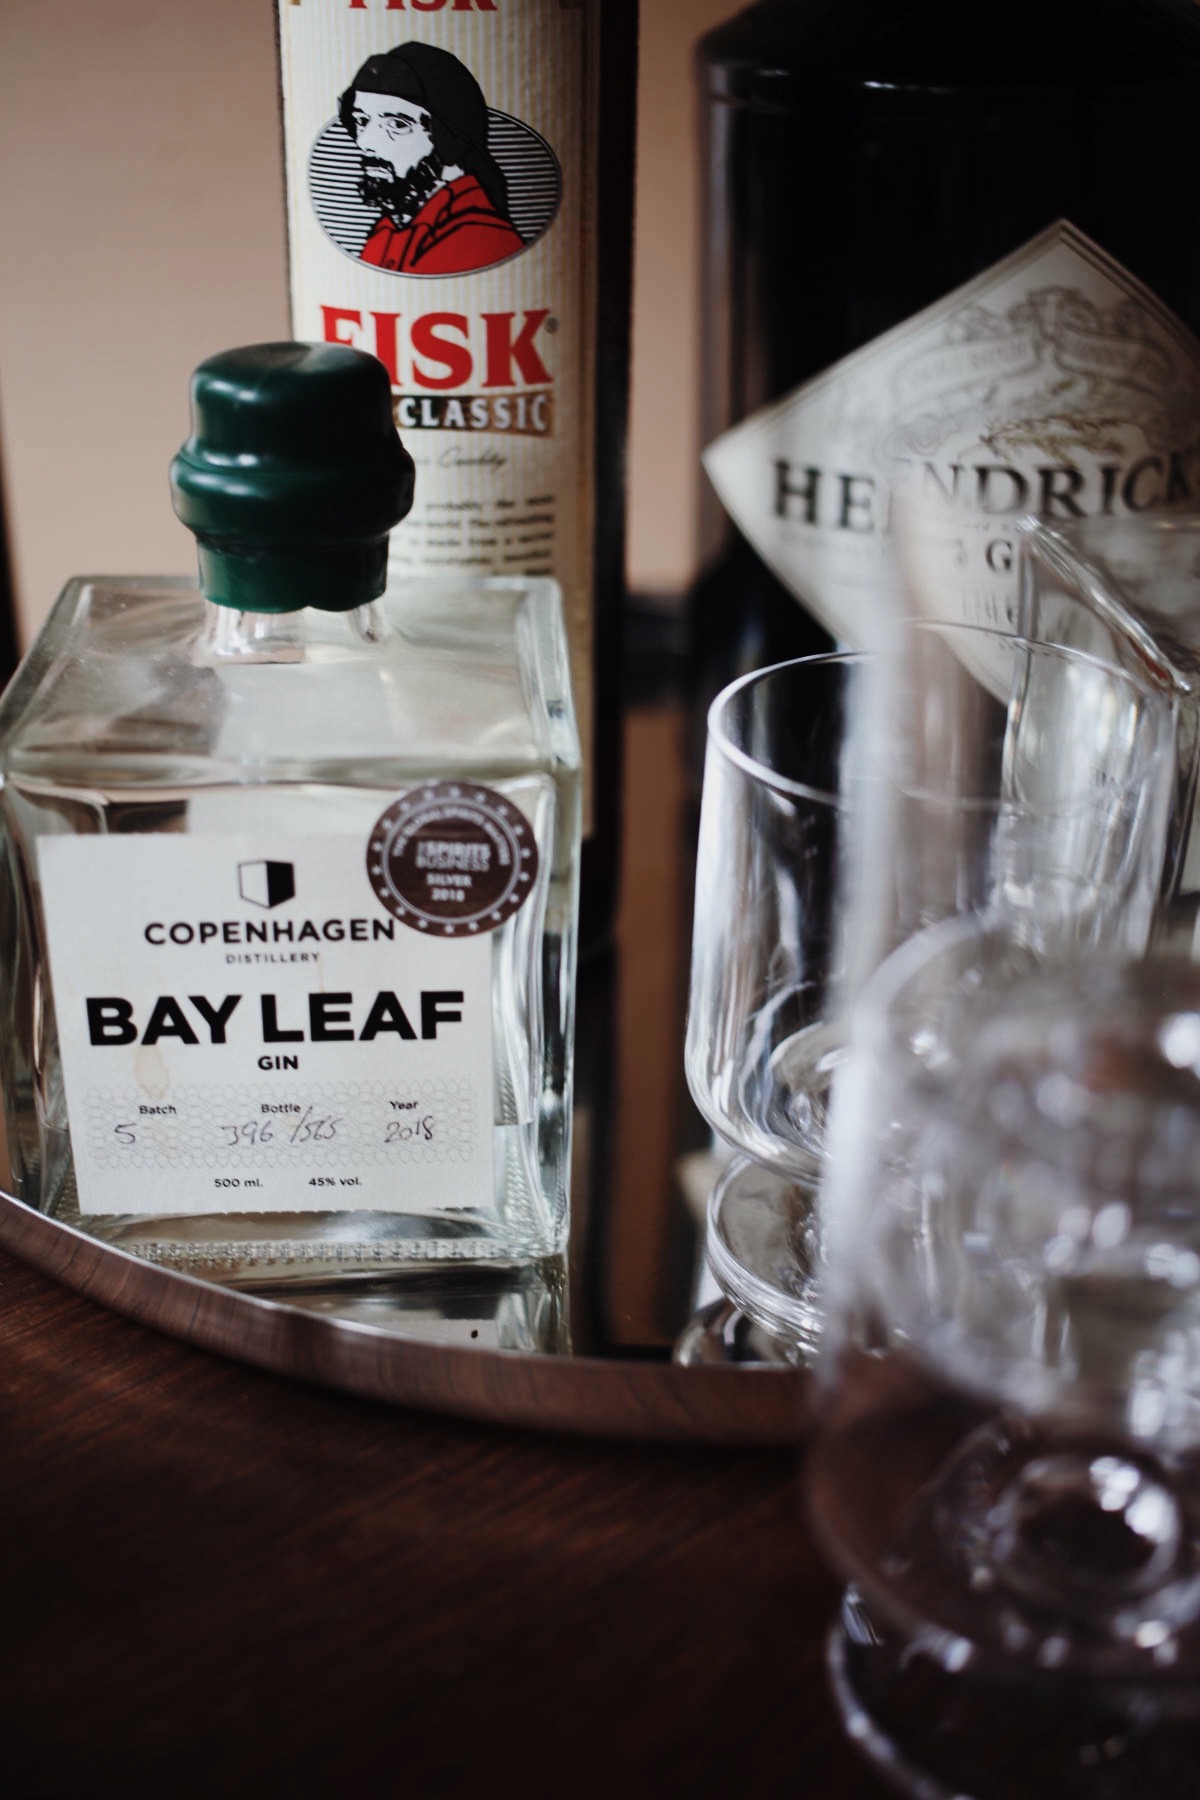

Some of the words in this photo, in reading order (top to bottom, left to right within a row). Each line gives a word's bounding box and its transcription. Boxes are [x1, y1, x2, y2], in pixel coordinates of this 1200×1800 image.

[398, 395, 547, 431] CLASSIC
[426, 873, 472, 888] SILVER
[143, 918, 396, 946] COPENHAGEN
[225, 952, 320, 965] DISTILLERY
[86, 995, 243, 1046] BAY
[260, 990, 465, 1043] LEAF
[257, 1055, 299, 1071] GIN
[138, 1105, 177, 1115] Batch
[260, 1103, 301, 1114] Bottle
[389, 1100, 419, 1111] Year
[383, 1115, 435, 1144] 2018
[214, 1178, 241, 1188] 500
[308, 1177, 336, 1187] 45%
